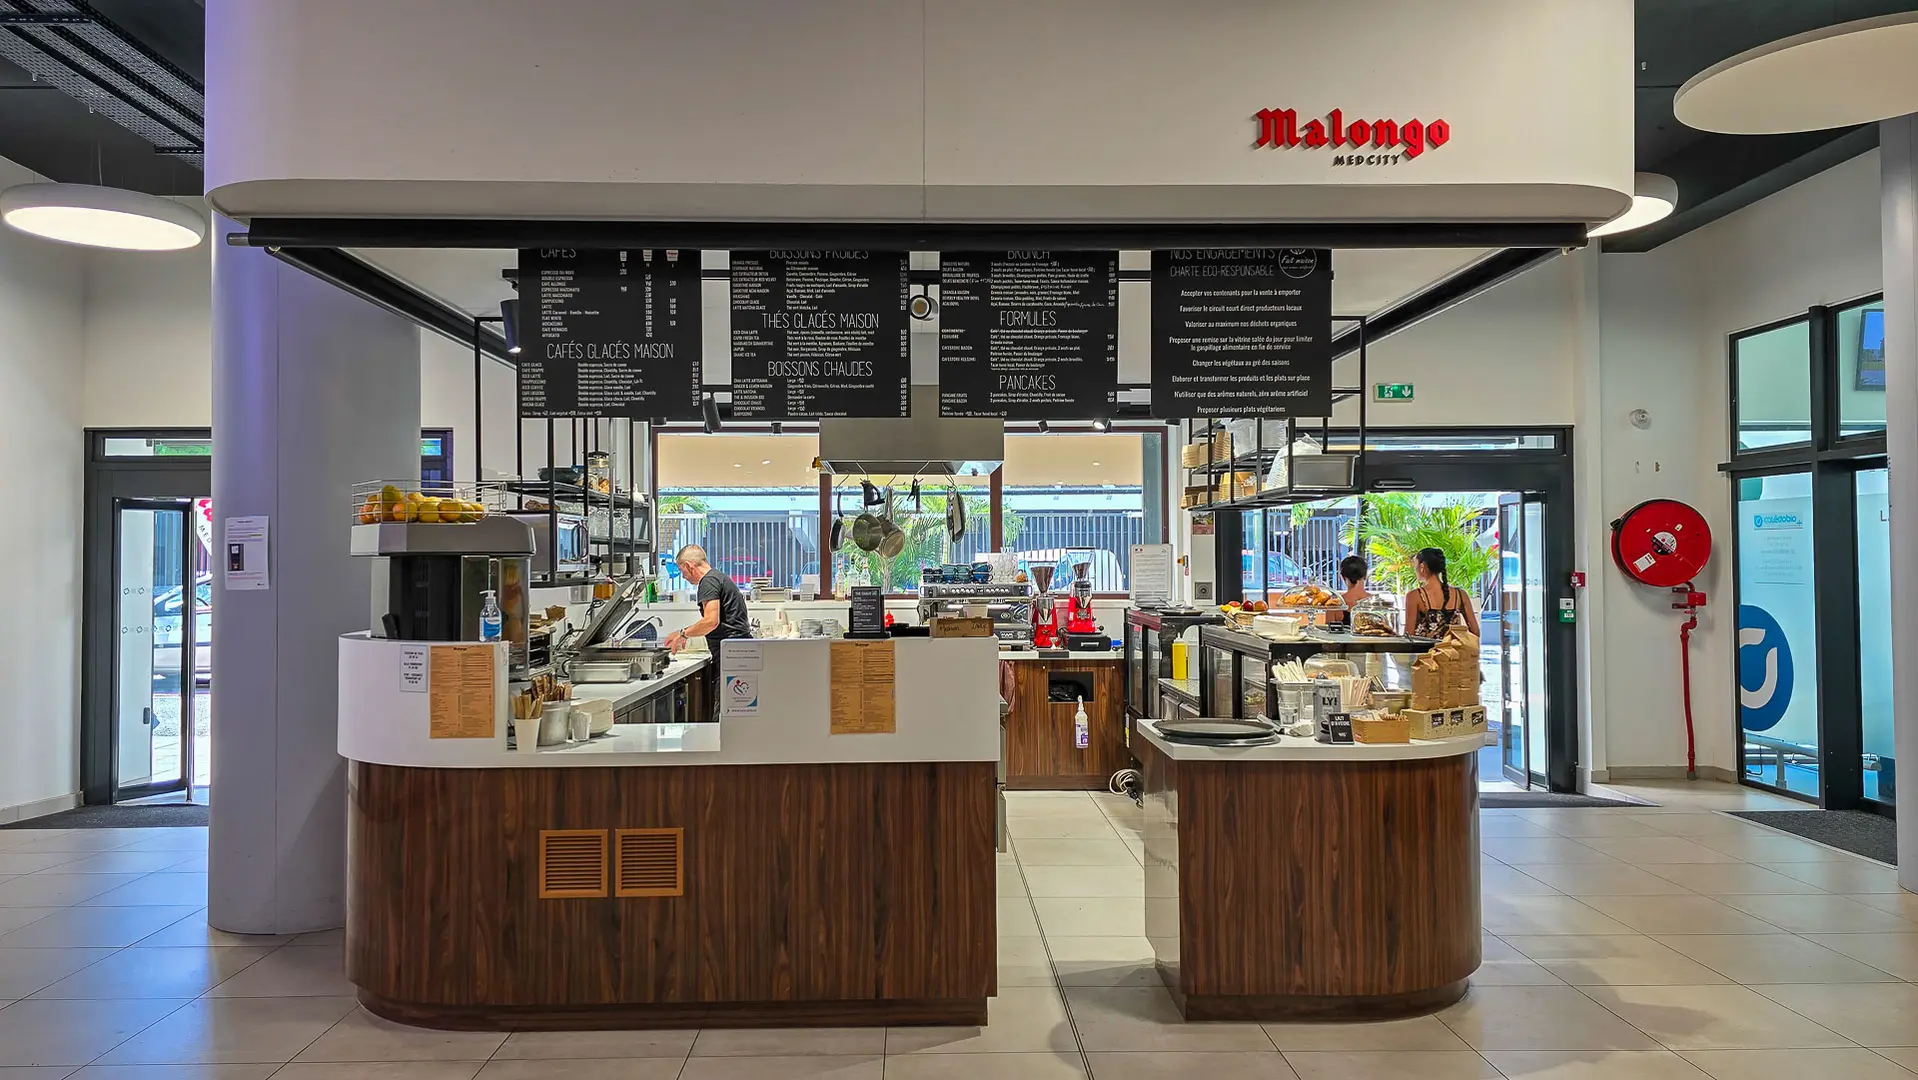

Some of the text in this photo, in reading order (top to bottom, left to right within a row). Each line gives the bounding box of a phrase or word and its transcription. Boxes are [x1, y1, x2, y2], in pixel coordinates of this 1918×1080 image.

[1254, 107, 1450, 160] Malongo
[1333, 154, 1401, 167] MEDCITY
[1170, 249, 1276, 260] NOS ENGAGEMENTS
[1170, 265, 1199, 277] CHARTE
[1203, 265, 1274, 277] ECO-RESPONSABLE
[762, 310, 879, 329] THÉS GLACÉS MAISON
[1000, 310, 1056, 327] FORMULES
[546, 340, 674, 359] CAFÉS GLACÉS MAISON
[768, 361, 873, 377] BOISSONS CHAUDES
[999, 374, 1056, 391] PANCAKES
[1322, 697, 1337, 706] LY!
